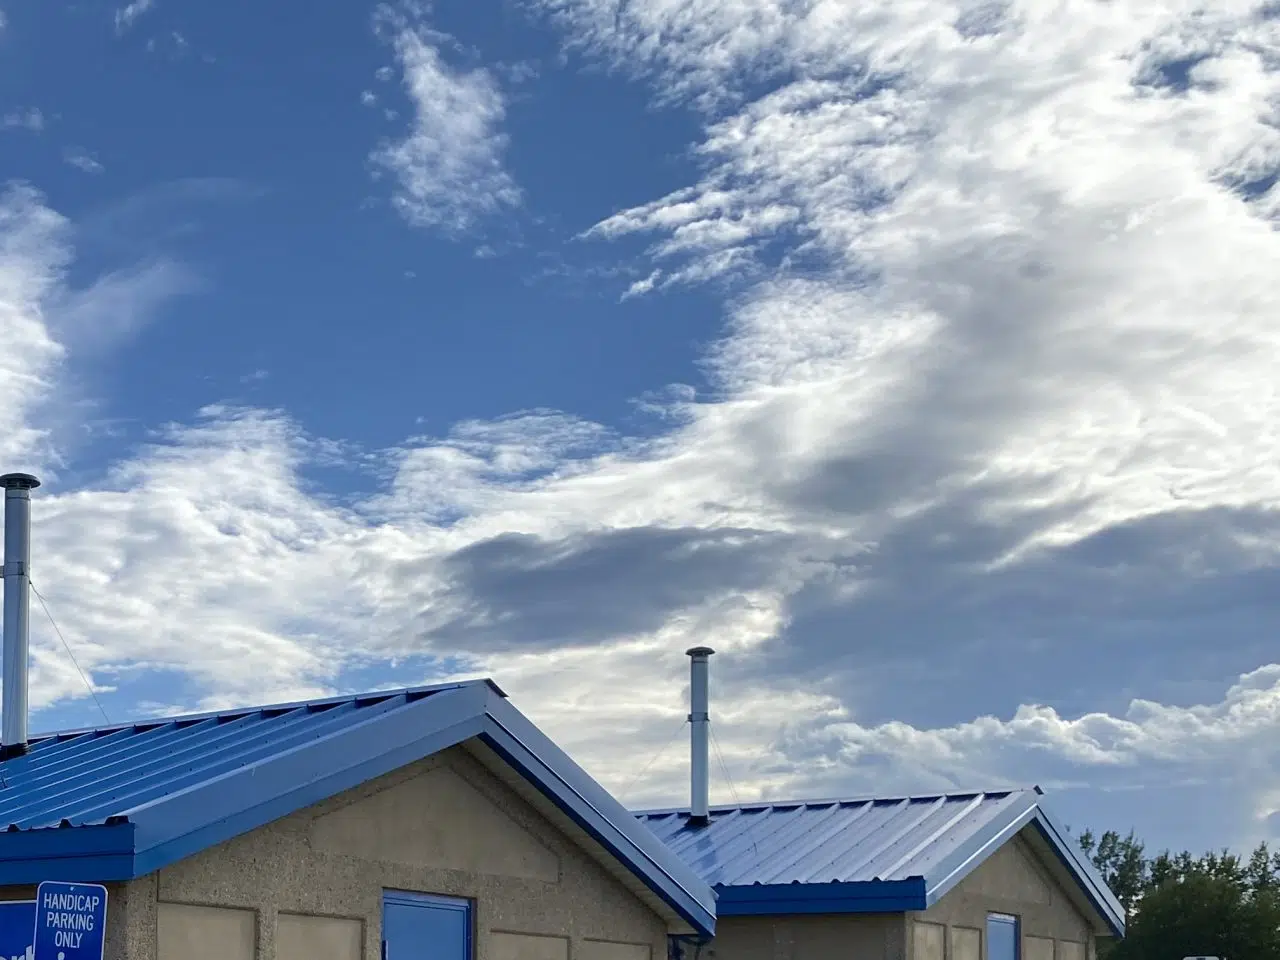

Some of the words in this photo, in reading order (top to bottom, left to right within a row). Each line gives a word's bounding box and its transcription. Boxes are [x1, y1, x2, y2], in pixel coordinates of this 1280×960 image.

[43, 893, 100, 912] HANDICAP
[46, 912, 94, 931] PARKING
[54, 931, 83, 949] ONLY
